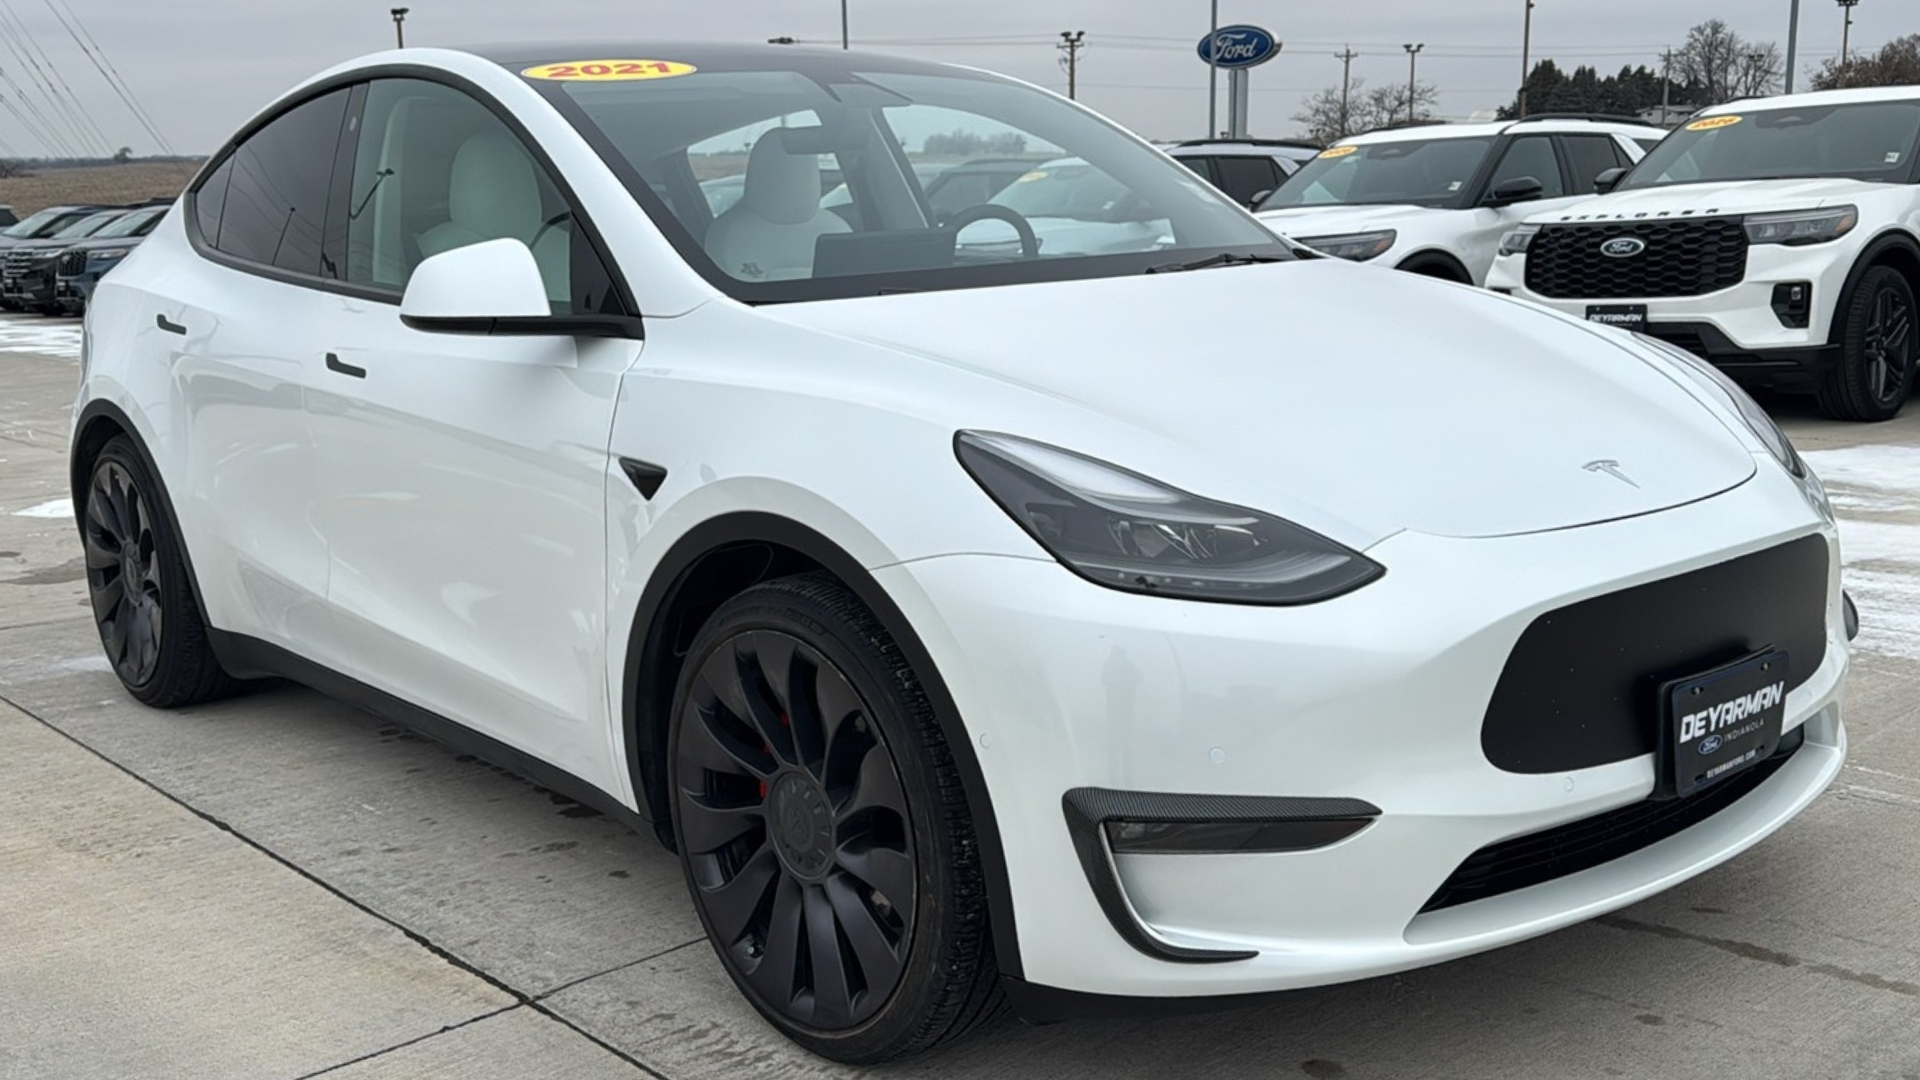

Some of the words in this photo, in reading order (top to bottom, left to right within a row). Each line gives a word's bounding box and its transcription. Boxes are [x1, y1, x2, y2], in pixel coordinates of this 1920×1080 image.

[1214, 33, 1258, 59] Ford
[546, 61, 671, 78] 2021
[1560, 208, 1719, 221] EXPLORER
[1589, 313, 1643, 323] DEYARMAN
[1679, 681, 1784, 743] DEYARMAN
[1724, 718, 1764, 743] INDIANOLA
